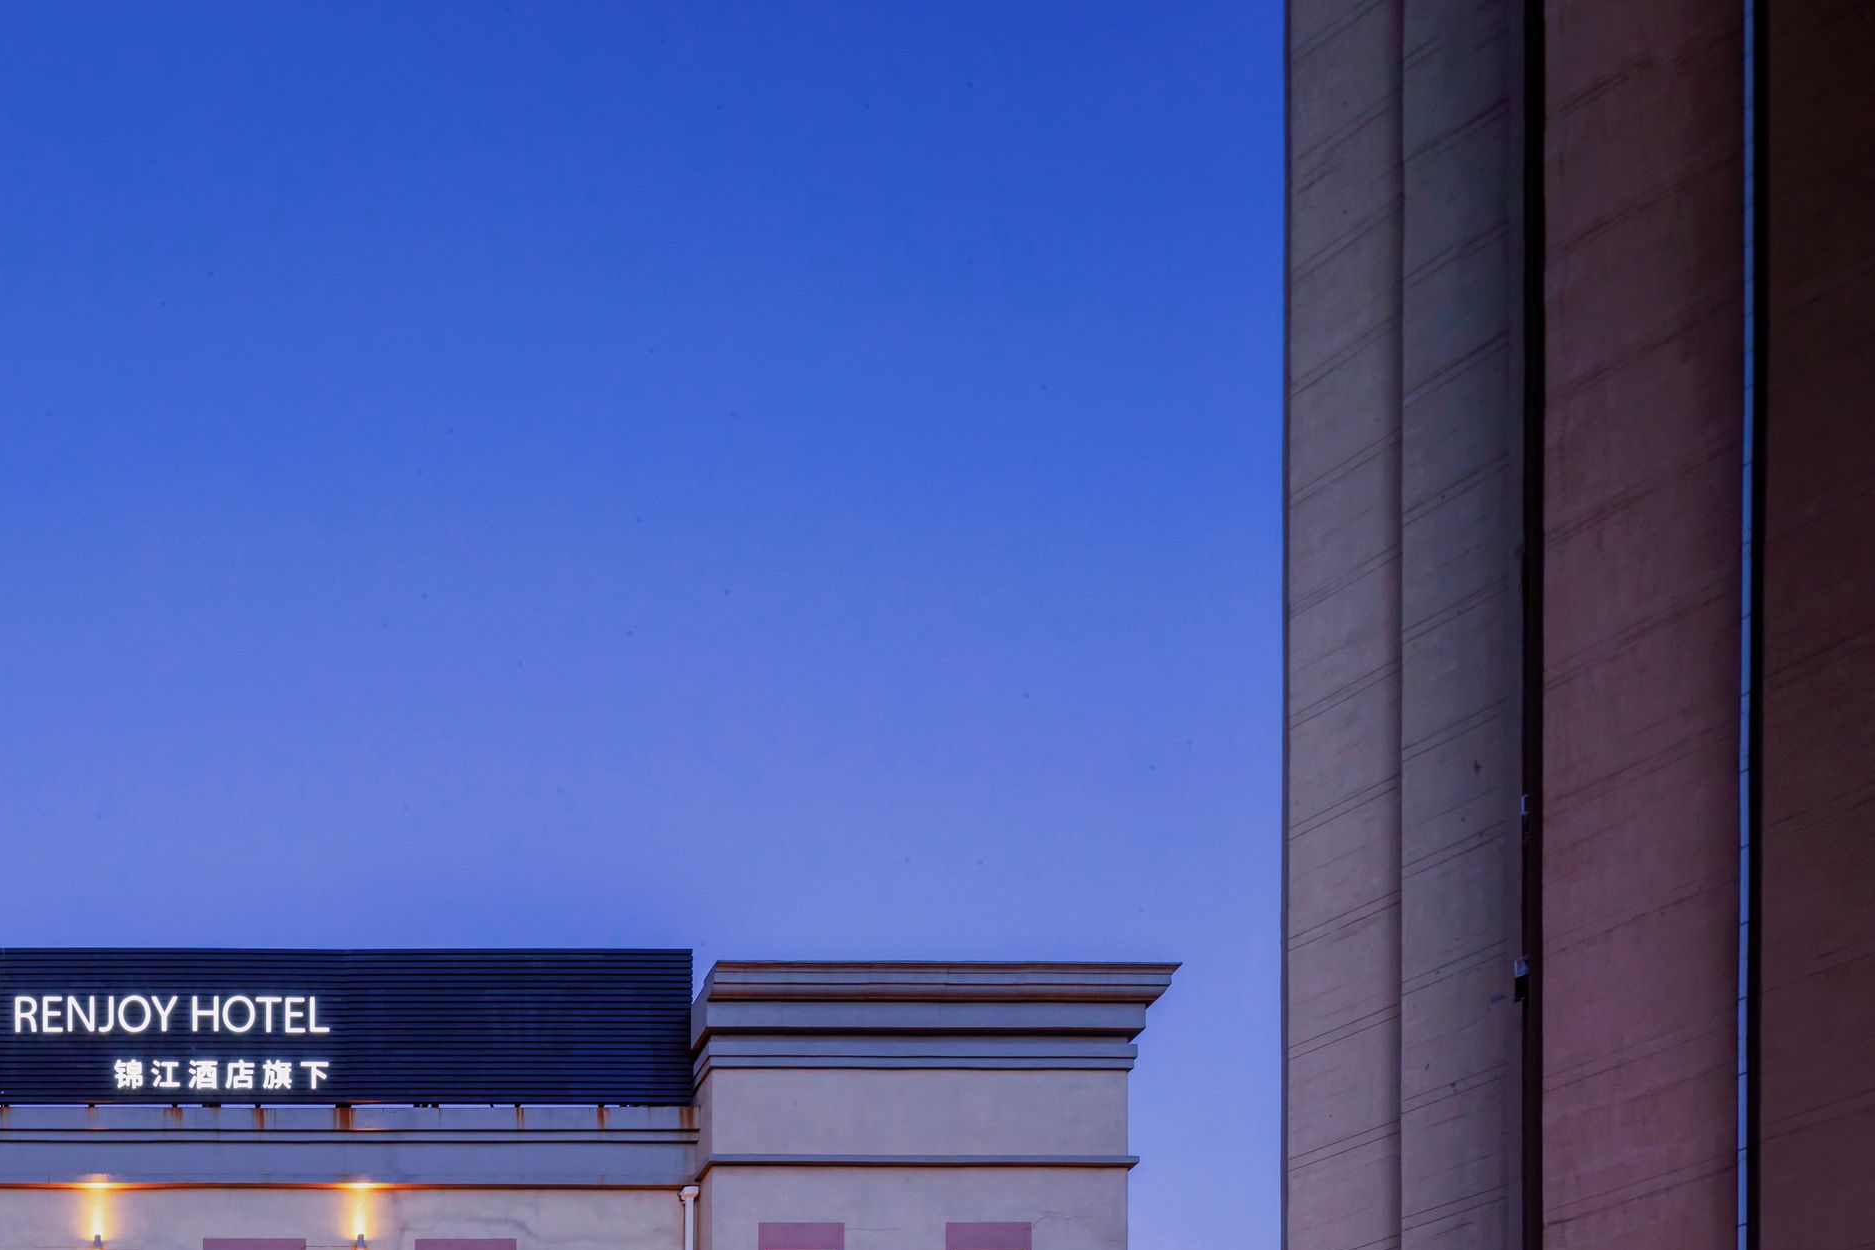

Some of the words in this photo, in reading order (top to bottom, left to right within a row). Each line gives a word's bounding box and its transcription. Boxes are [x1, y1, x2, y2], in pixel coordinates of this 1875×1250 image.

[14, 995, 179, 1034] RENJOY
[191, 995, 331, 1034] HOTEL
[113, 1058, 331, 1090] 锦江酒店旗下
